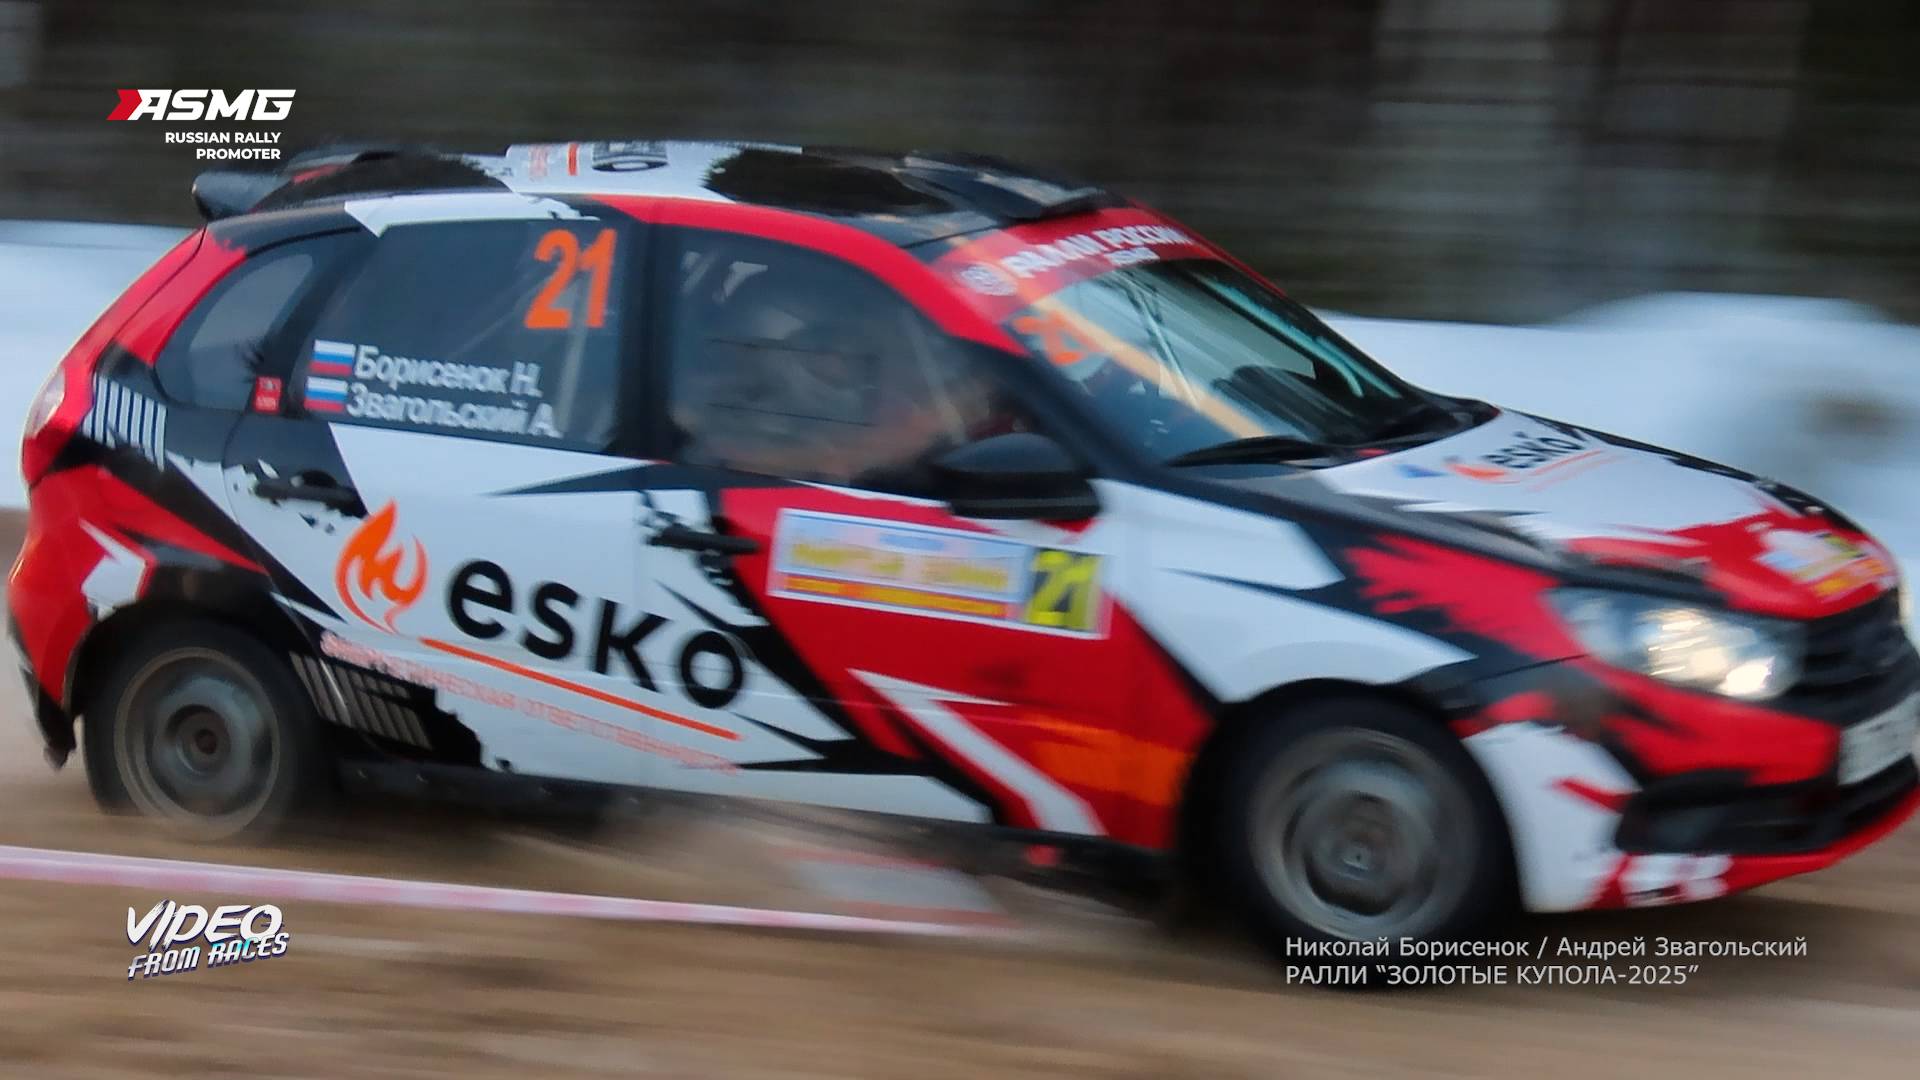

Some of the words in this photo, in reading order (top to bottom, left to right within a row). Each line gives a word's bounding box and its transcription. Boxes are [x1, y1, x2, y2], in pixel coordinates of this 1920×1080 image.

[524, 228, 618, 330] 21
[346, 382, 529, 434] Звагольский
[355, 344, 511, 391] Борисенок
[1026, 546, 1099, 631] 21
[445, 559, 744, 709] esko
